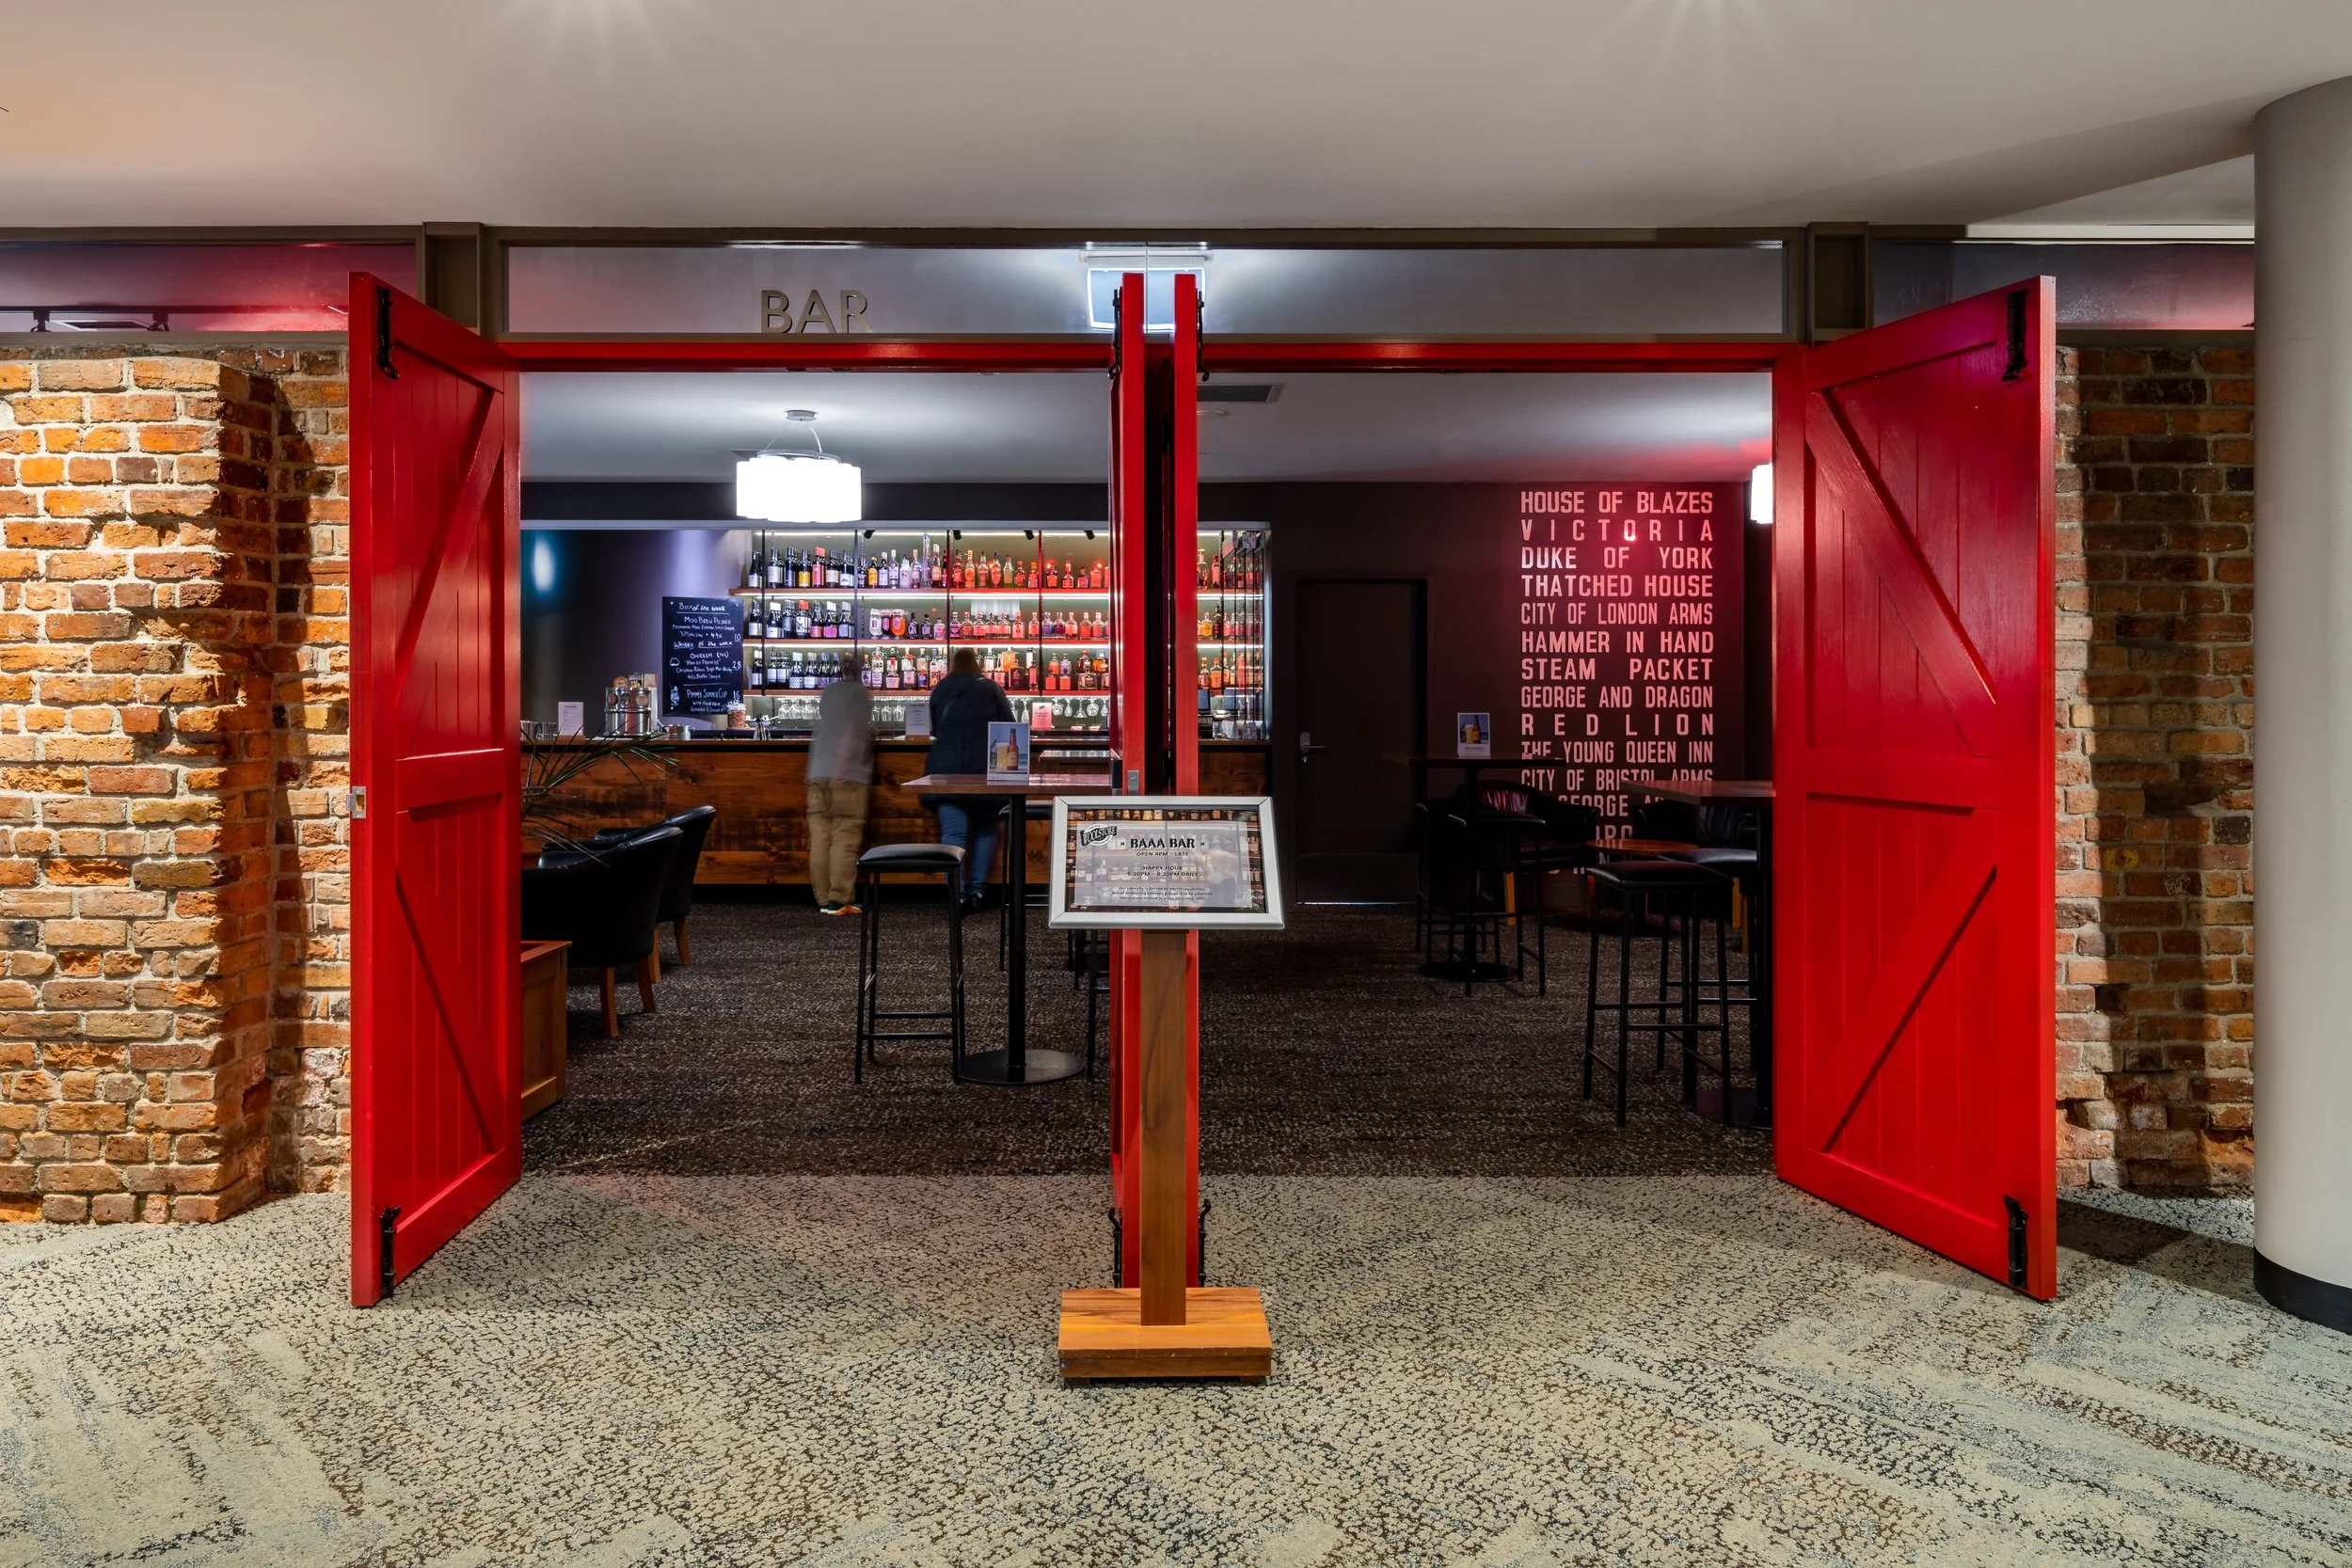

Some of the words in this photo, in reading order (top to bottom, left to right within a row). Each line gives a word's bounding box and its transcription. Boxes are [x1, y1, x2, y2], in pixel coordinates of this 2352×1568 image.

[761, 289, 874, 333] BAR
[1521, 492, 1584, 514] HOUSE
[1598, 492, 1623, 514] OF
[1637, 492, 1713, 514] BLAZES
[1521, 519, 1713, 541] VICTORIA
[1521, 546, 1577, 569] DUKE
[1603, 546, 1629, 569] OF
[1659, 546, 1713, 569] YORK
[1521, 575, 1632, 596] THATCHED
[1645, 575, 1713, 597] HOUSE
[1521, 603, 1556, 625] CITY
[1567, 603, 1586, 625] OF
[1598, 603, 1658, 625] LONDON
[1669, 603, 1713, 625] ARMS
[1521, 631, 1610, 653] HAMMER
[1627, 631, 1645, 653] IN
[1661, 631, 1714, 653] HAND
[1521, 658, 1596, 680] STEAM
[1629, 658, 1713, 680] PACKET
[733, 690, 740, 700] 16
[1521, 687, 1586, 707] GEORGE
[1599, 687, 1632, 707] AND
[1645, 687, 1713, 707] DRAGON
[1521, 714, 1599, 736] RED
[1626, 714, 1713, 736] LION
[1563, 741, 1613, 763] YOUNG
[1626, 741, 1677, 763] QUEEN
[1688, 741, 1713, 763] INN
[1521, 769, 1555, 791] CITY
[1566, 769, 1584, 791] OF
[1130, 838, 1166, 848] BAAA
[1169, 838, 1196, 848] BAR
